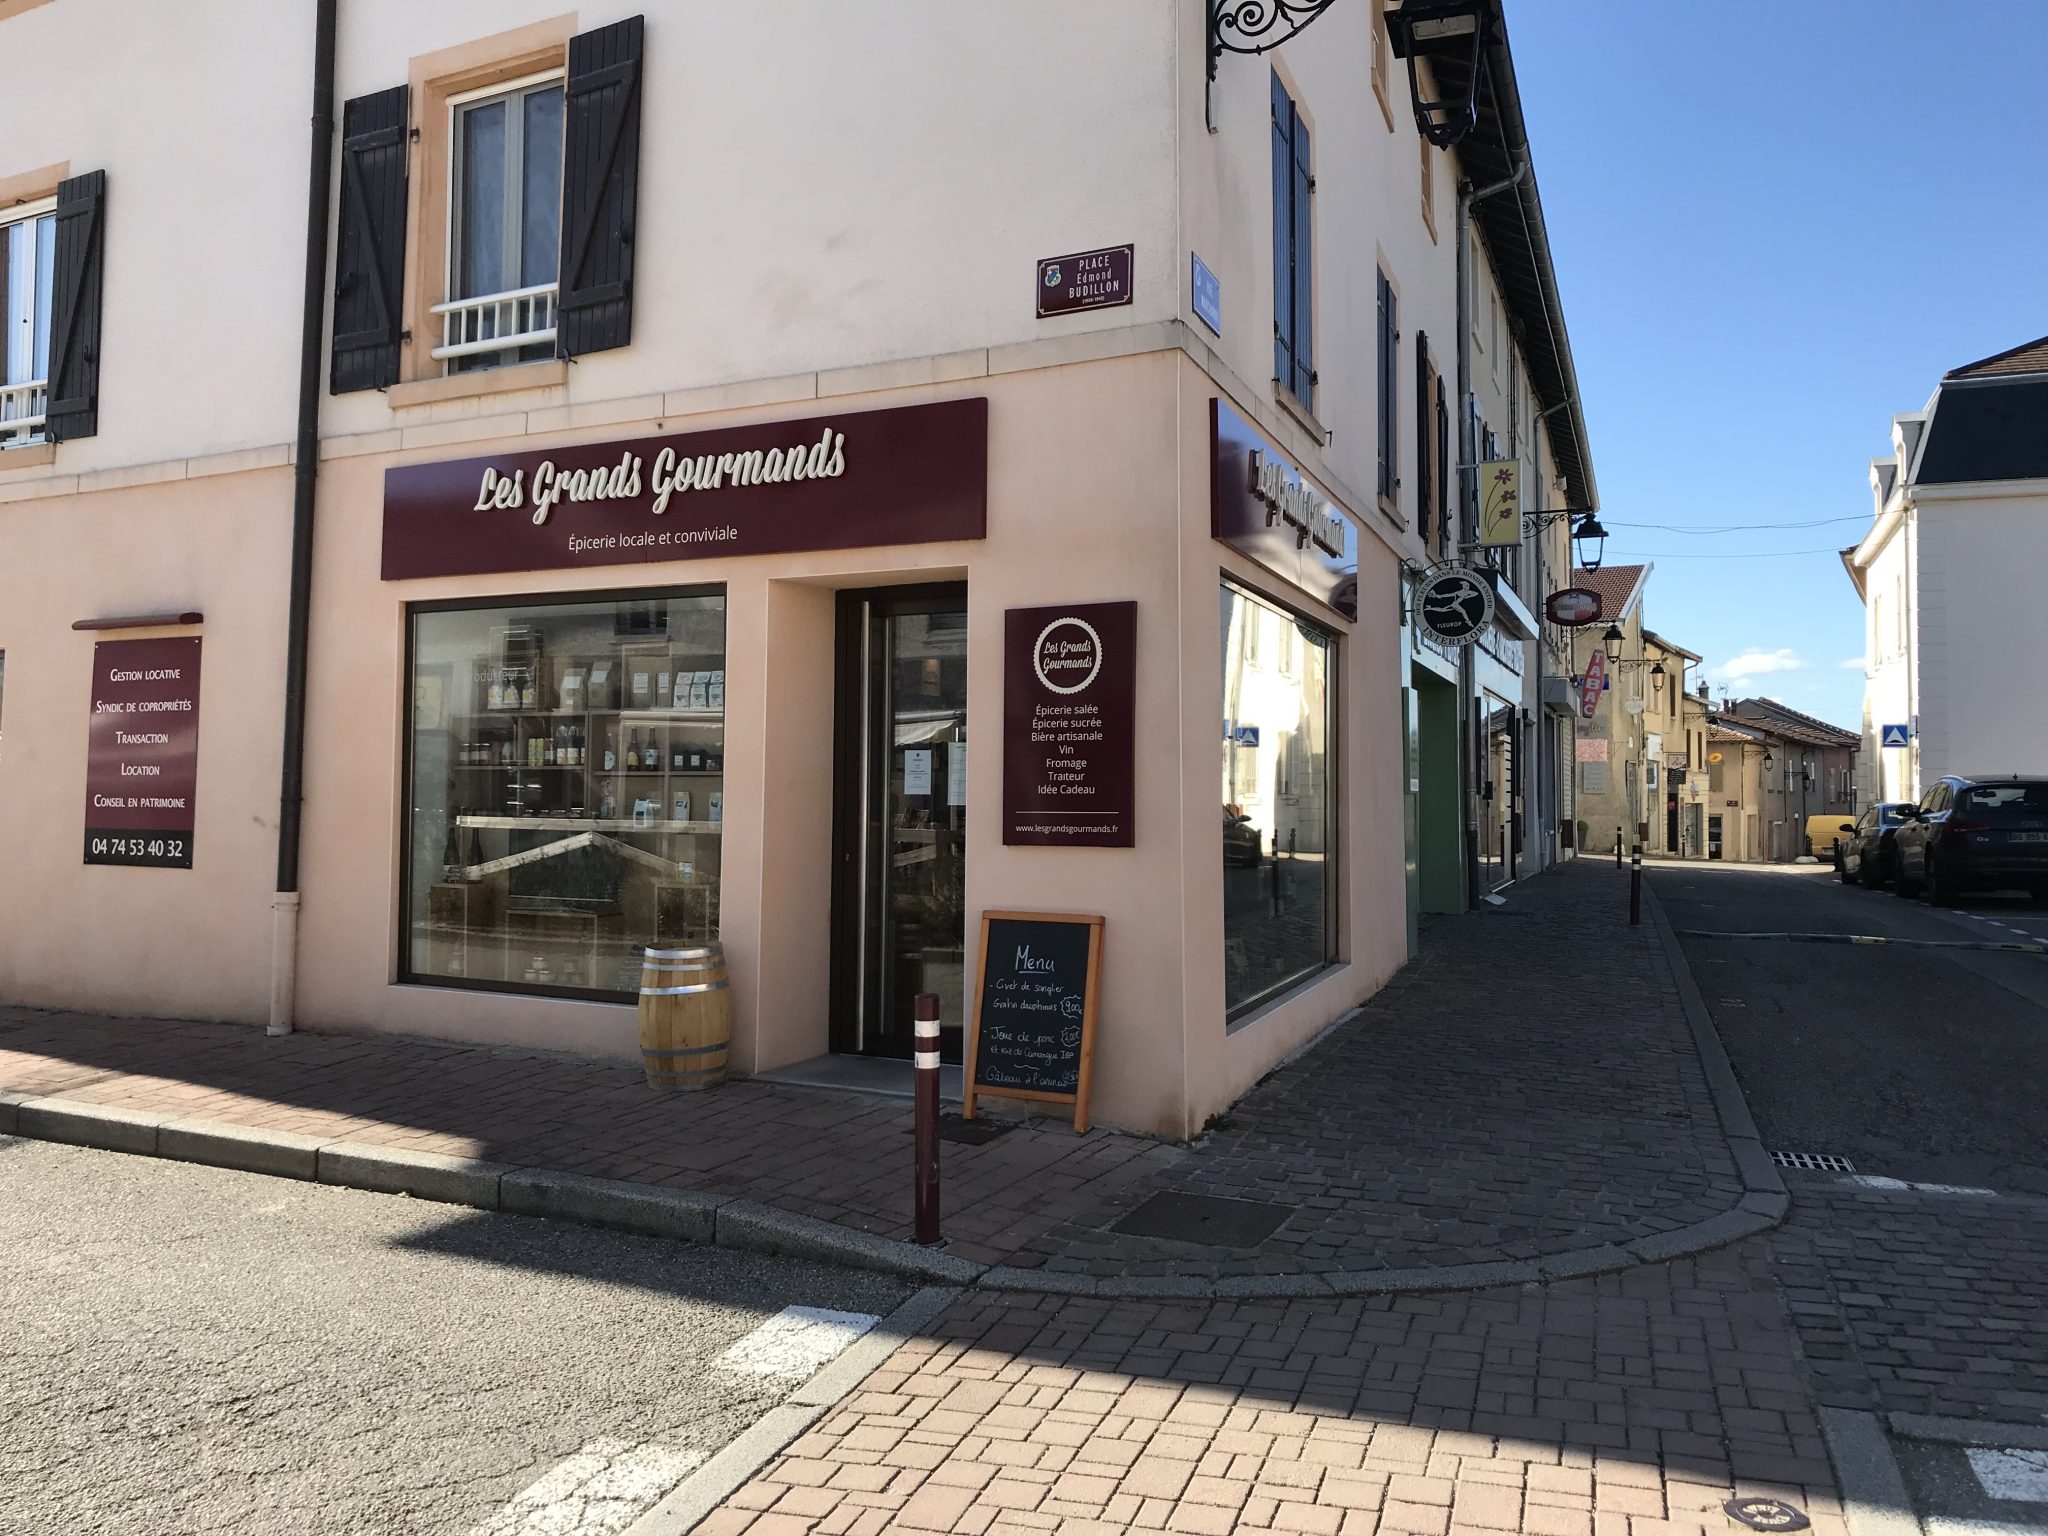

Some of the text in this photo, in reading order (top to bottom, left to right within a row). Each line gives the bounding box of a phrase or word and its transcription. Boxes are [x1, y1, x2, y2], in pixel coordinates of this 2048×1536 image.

[1079, 255, 1110, 271] PLACE
[1077, 268, 1112, 284] Edmond
[1069, 280, 1120, 299] BUDILLON
[473, 427, 845, 525] Les Grands Gourmands
[568, 524, 738, 553] Épicerie locale et conviviale
[1433, 570, 1451, 581] DANS
[1423, 620, 1489, 645] INTERFLORA
[1043, 640, 1091, 658] Les Grands
[1043, 656, 1092, 675] Gourmands
[1583, 652, 1604, 715] TABAC
[1036, 704, 1099, 717] Épicerie salée
[1032, 717, 1102, 731] Épicerie sucrée
[1031, 731, 1103, 742] Bière artisanale
[1059, 745, 1074, 755] Vin
[1046, 758, 1087, 770] Fromage
[1048, 771, 1085, 781] Traiteur
[1038, 783, 1095, 794] Idée Cadeau
[1015, 823, 1119, 835] www.lesgrandsgourmands.fr
[92, 838, 183, 857] 04 74 53 40 32
[1014, 944, 1055, 972] Menu
[1021, 981, 1031, 991] de
[1034, 982, 1065, 996] sanglier
[990, 1026, 1013, 1040] Joue
[1017, 1032, 1029, 1042] de
[1034, 1035, 1055, 1047] porc
[986, 1065, 1021, 1082] Gâteau
